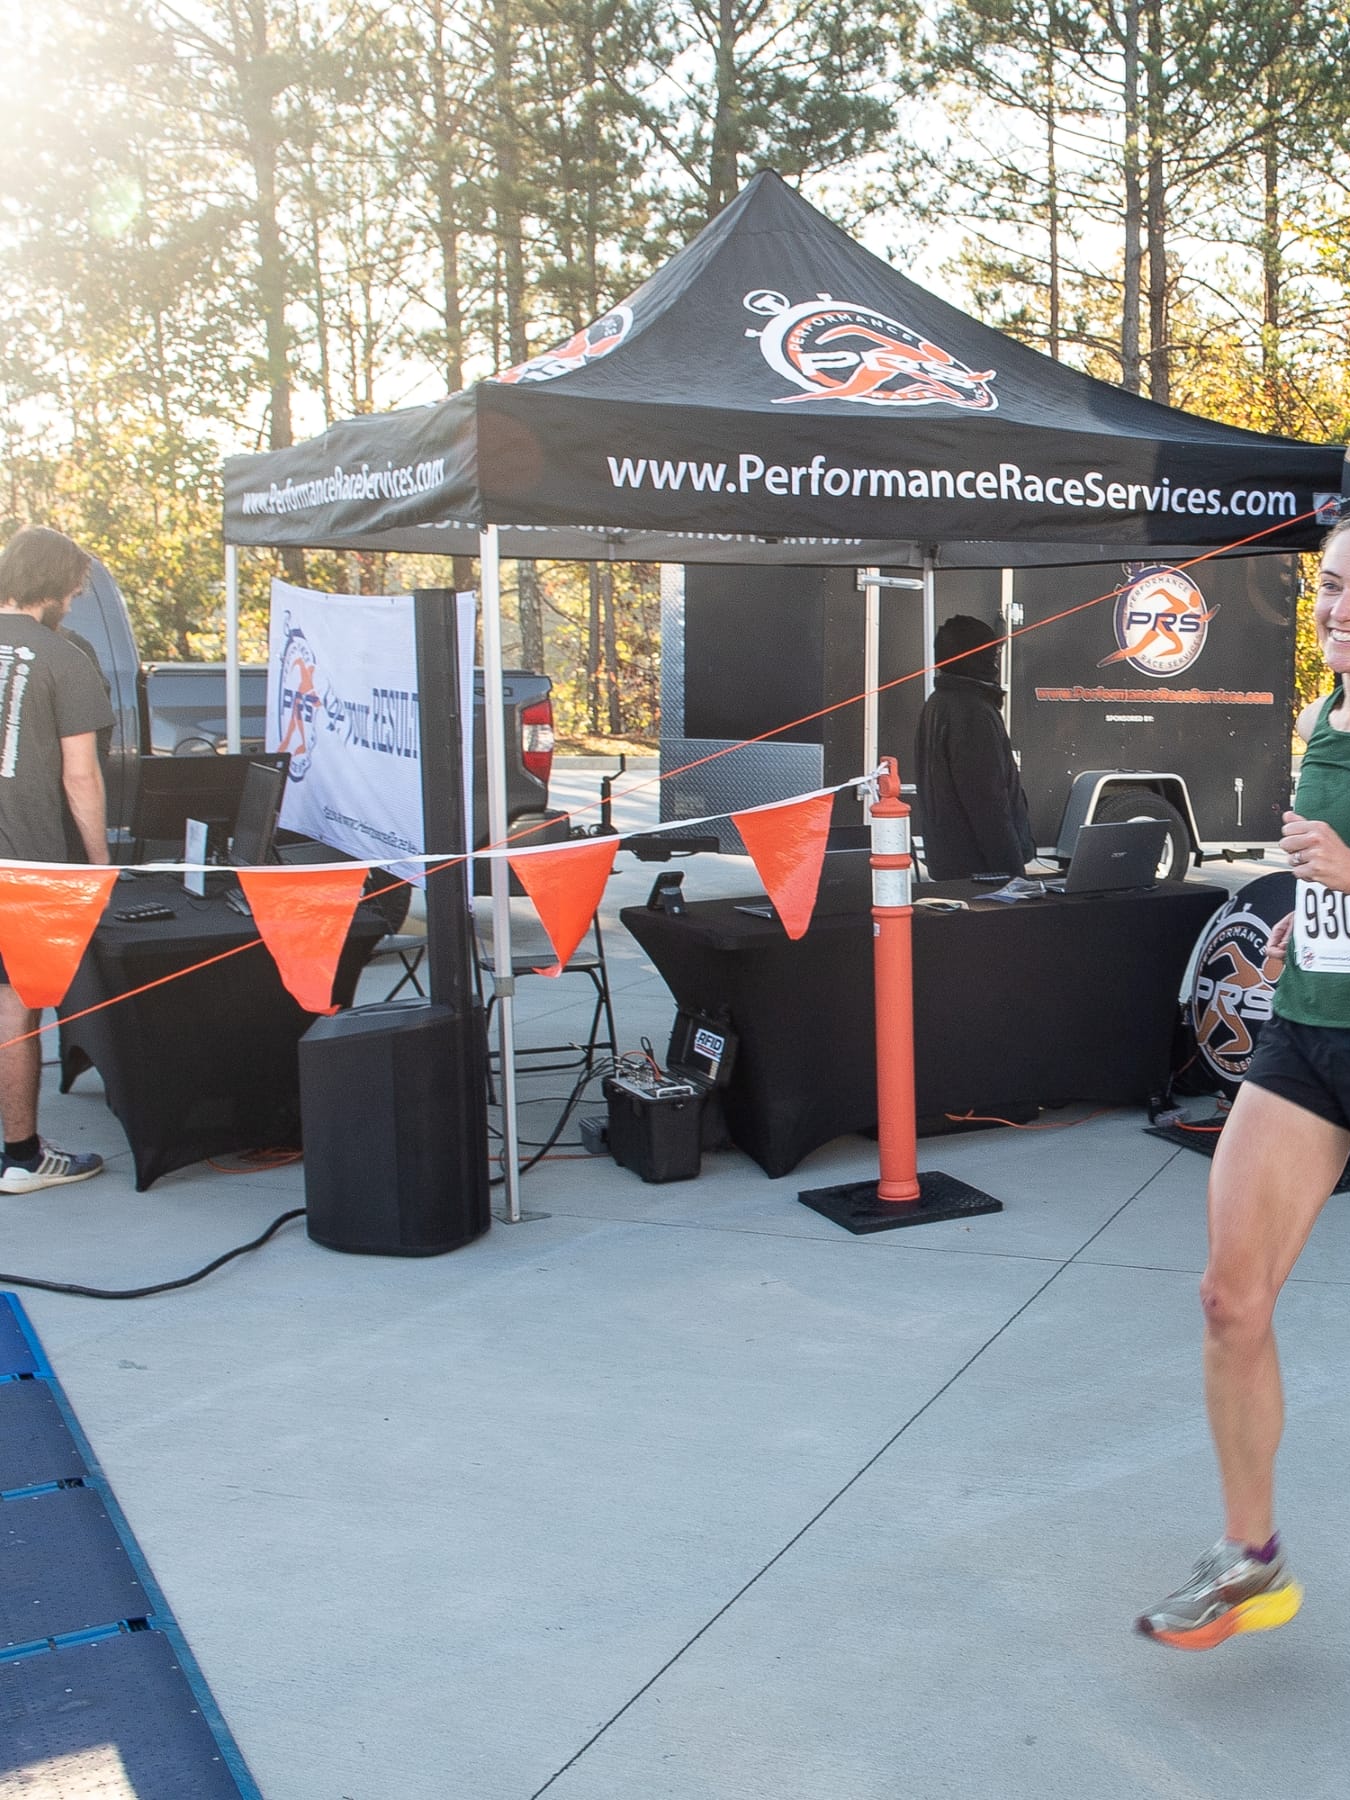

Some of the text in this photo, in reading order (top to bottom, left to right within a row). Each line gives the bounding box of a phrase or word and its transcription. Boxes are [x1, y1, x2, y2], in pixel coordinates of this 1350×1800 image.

[789, 312, 913, 351] PERFORMANCE
[797, 350, 977, 389] PRS
[242, 457, 445, 515] www.PerformanceRaceServices.com
[606, 453, 1297, 516] www.PerformanceRaceServices.com
[1128, 577, 1188, 609] PERFORMANCE
[1126, 611, 1201, 633] PRS
[1197, 975, 1274, 1021] PRS
[697, 1031, 722, 1051] RFID
